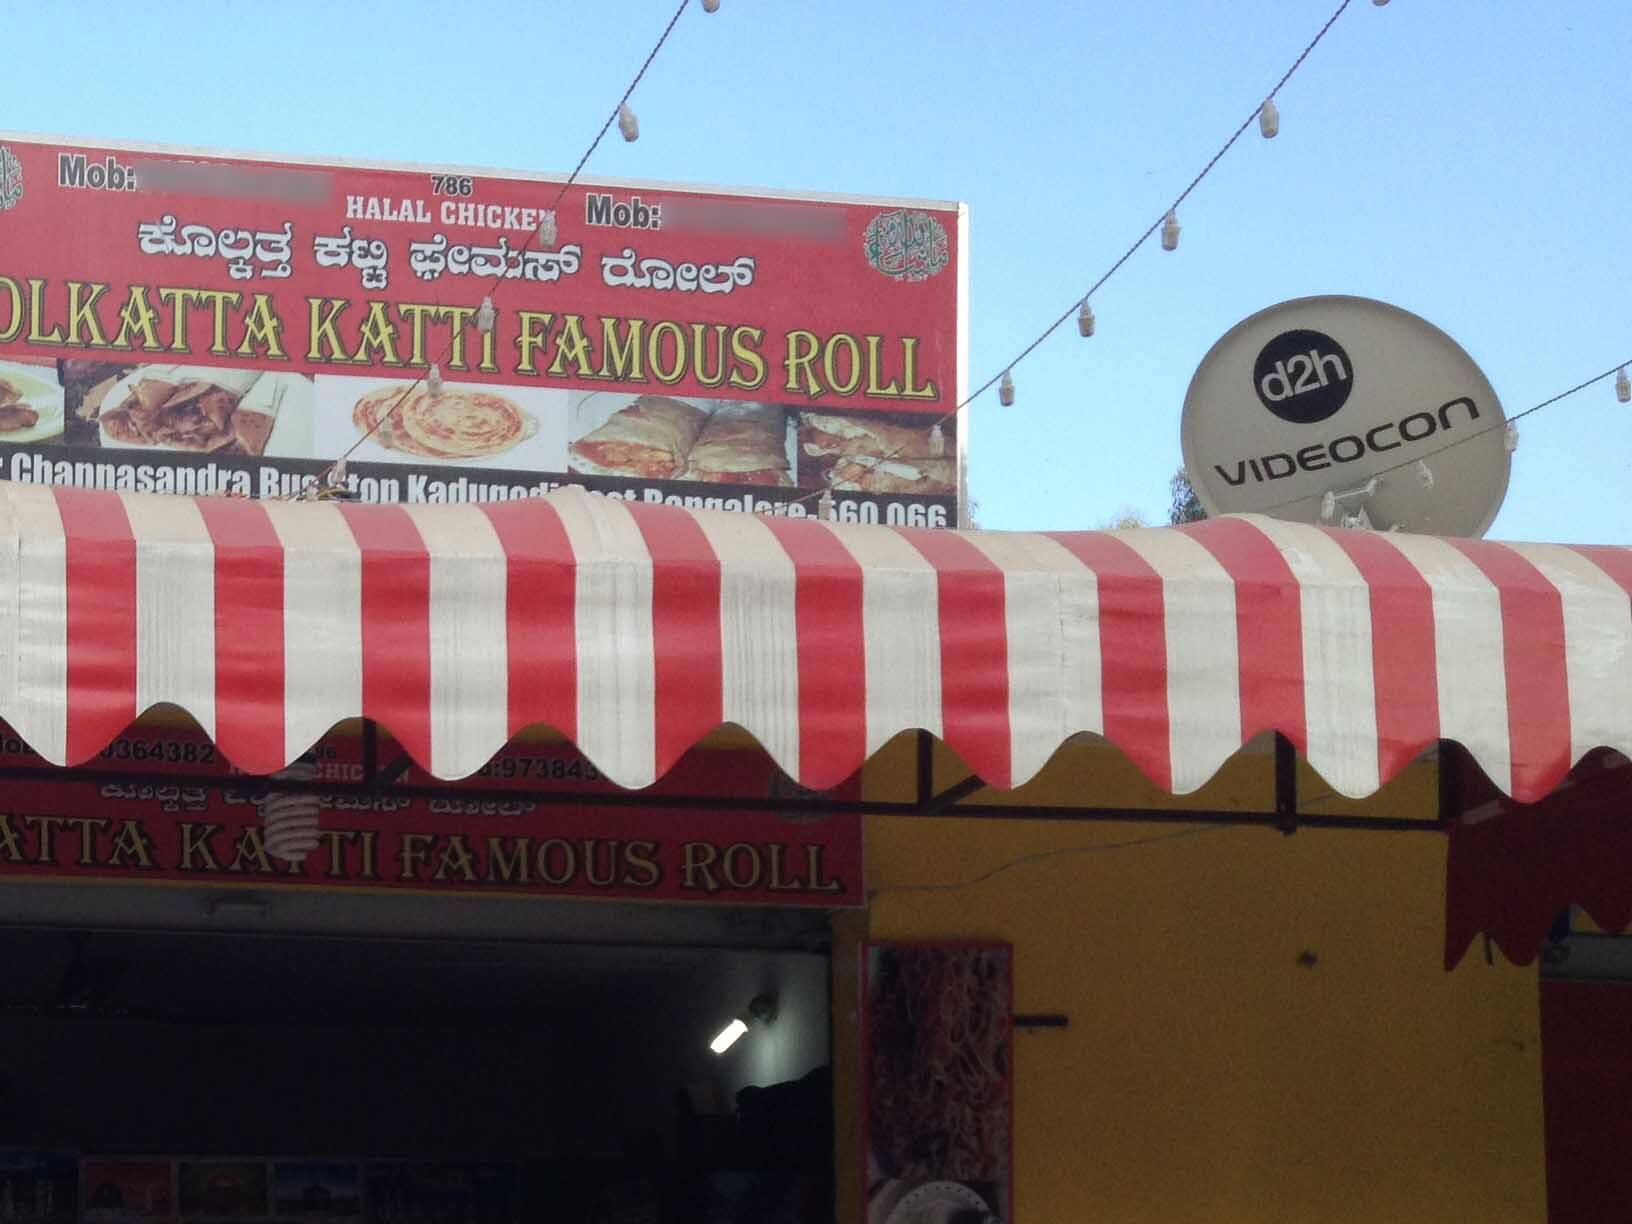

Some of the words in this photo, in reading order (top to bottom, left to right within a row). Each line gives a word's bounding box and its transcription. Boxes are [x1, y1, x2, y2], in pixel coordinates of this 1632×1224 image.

[58, 153, 136, 191] Mob:
[431, 176, 473, 196] 786
[345, 195, 432, 223] HALAL
[585, 192, 662, 229] Mob:
[602, 248, 756, 294] ರೋಲ್
[305, 296, 502, 373] KATTI
[514, 309, 766, 391] FAMOUS
[784, 330, 940, 400] ROLL
[1260, 348, 1347, 403] d2h
[1214, 395, 1481, 487] VIDEOCON
[329, 471, 401, 503] top
[177, 822, 377, 882] KATI
[398, 833, 663, 889] FAMOUS
[680, 842, 846, 894] ROLL
